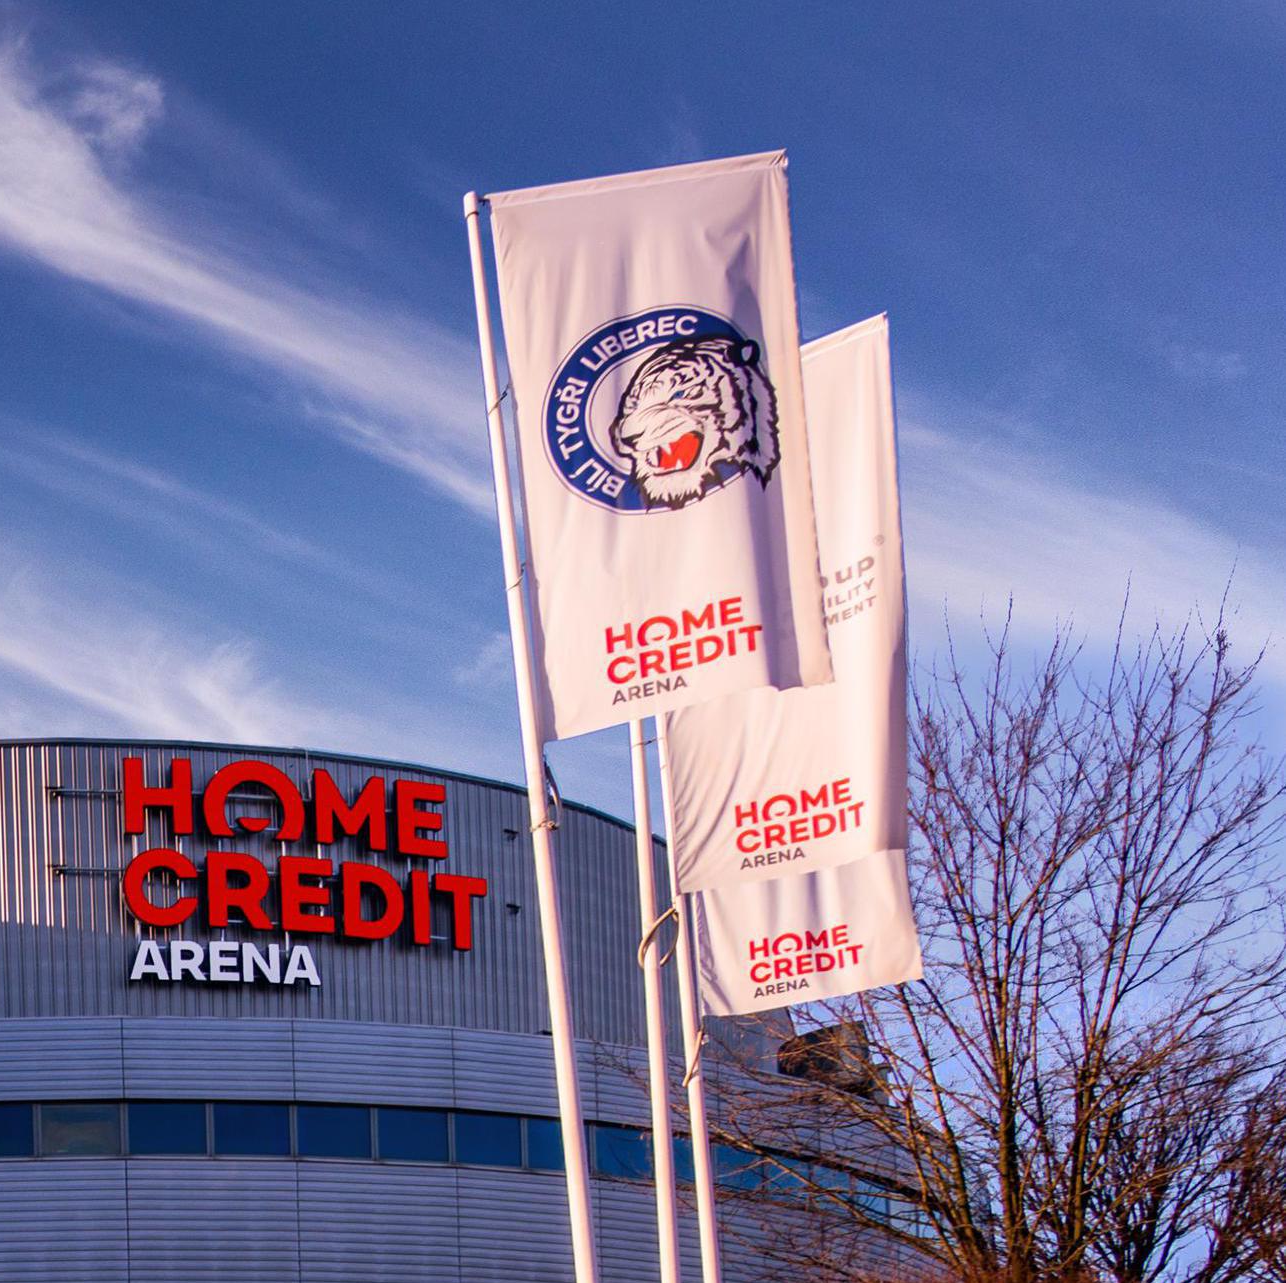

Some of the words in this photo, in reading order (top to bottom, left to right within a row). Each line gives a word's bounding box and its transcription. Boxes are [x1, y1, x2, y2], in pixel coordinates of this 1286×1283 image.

[579, 314, 699, 371] LIBEREC
[555, 376, 589, 460] TYGŘI
[570, 458, 626, 499] BÍLÍ
[605, 596, 744, 653] HOME
[606, 625, 763, 684] CREDIT
[612, 675, 688, 705] ARENA
[122, 757, 449, 859] HOME
[734, 778, 852, 828] HOME
[736, 801, 865, 854] CREDIT
[740, 847, 806, 870] ARENA
[122, 848, 488, 952] CREDIT
[130, 940, 322, 986] ARENA
[749, 924, 849, 961] HOME
[750, 944, 864, 983] CREDIT
[753, 978, 810, 999] ARENA
